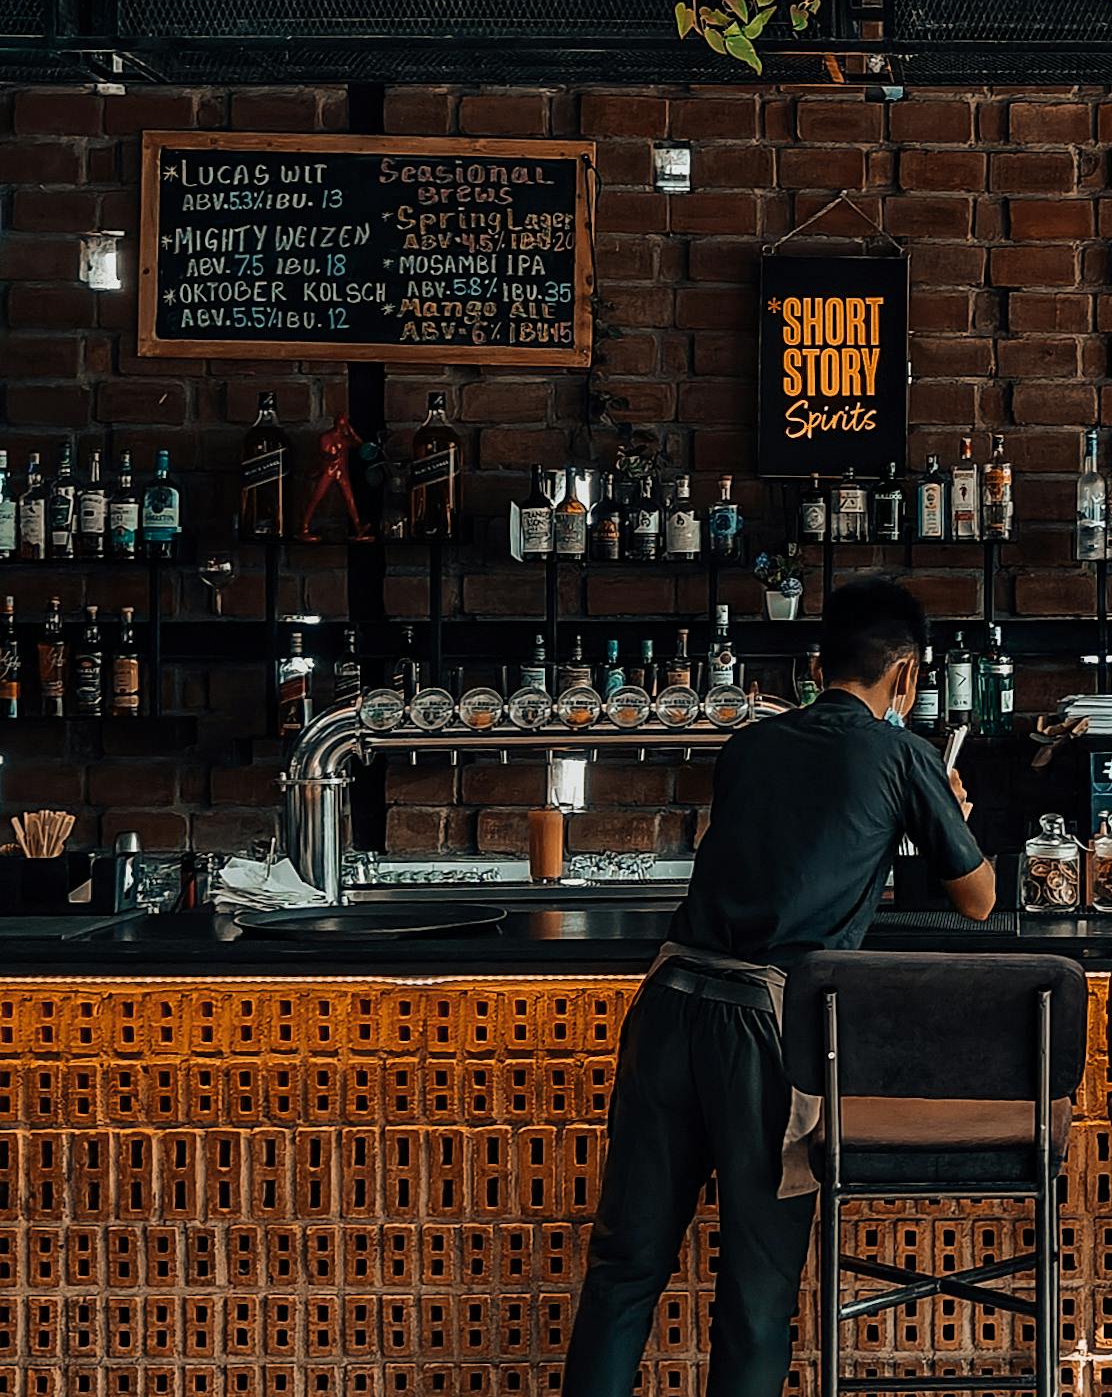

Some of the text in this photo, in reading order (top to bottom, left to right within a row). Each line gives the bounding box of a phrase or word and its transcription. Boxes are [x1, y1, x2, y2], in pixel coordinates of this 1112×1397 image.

[181, 159, 270, 187] LUCAS
[173, 222, 371, 254] MIGHTY WEIZEN
[326, 254, 347, 276] 18
[399, 254, 546, 277] MOSAMBI IPA
[179, 281, 386, 304] OKTOBER KOLSCH
[328, 307, 350, 330] 12
[396, 298, 498, 325] Mango
[782, 297, 884, 346] SHORT
[782, 348, 881, 397] STORY
[785, 399, 878, 439] Spirits
